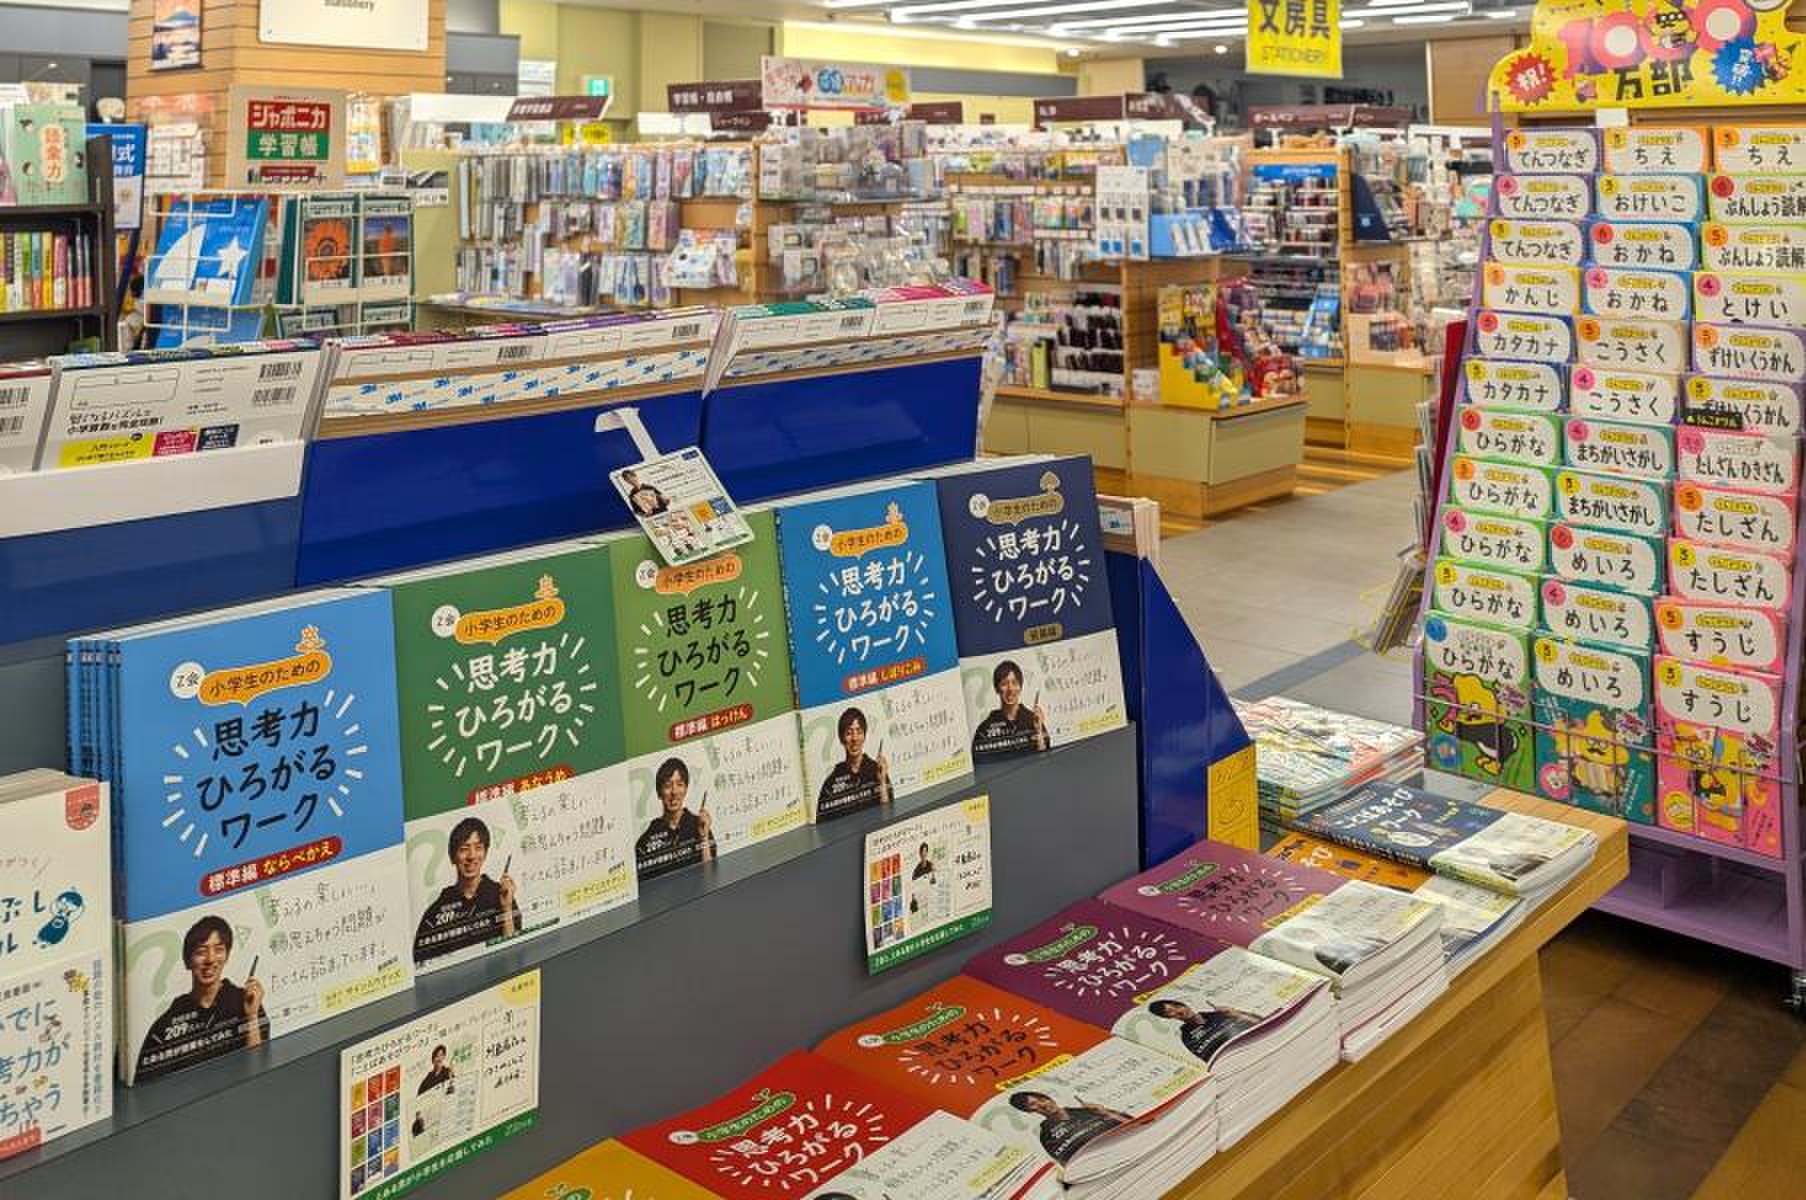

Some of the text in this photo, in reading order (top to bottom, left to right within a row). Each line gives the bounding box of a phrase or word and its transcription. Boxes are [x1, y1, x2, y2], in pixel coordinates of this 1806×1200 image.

[1615, 59, 1695, 101] 万部
[252, 104, 327, 129] ジャポニカ
[258, 133, 319, 157] 学習帳
[1518, 148, 1589, 168] てんつなぎ
[1635, 147, 1676, 165] ちえ
[1749, 146, 1793, 166] ちえ
[1510, 193, 1580, 212] てんつなぎ
[1615, 194, 1687, 213] おけいこ
[1502, 240, 1573, 260] てんつなぎ
[1613, 245, 1676, 264] おかね
[1505, 287, 1560, 308] かんじ
[1607, 292, 1669, 312] おかね
[1722, 298, 1789, 318] とけい
[1494, 335, 1559, 357] カタカナ
[1596, 341, 1667, 364] こうさく
[1708, 351, 1796, 374] ずけいくうかん
[1483, 382, 1549, 404] カタカナ
[1589, 393, 1660, 417] こうさく
[1476, 431, 1546, 456] ひらがな
[1577, 444, 1665, 472] まちがいさがし
[1468, 484, 1539, 511] ひらがな
[1567, 496, 1656, 527] まちがいさがし
[997, 525, 1061, 561] 思考力
[1696, 511, 1779, 543] たしざん
[1460, 534, 1533, 563] ひらがな
[842, 557, 906, 597] 思考力
[991, 556, 1074, 594] ひろがる
[1571, 553, 1636, 581] めいろ
[1690, 567, 1775, 601] たしざん
[666, 594, 737, 638] 思考力
[834, 590, 918, 633] ひろがる
[1009, 587, 1066, 621] ワーク
[1451, 587, 1524, 618] ひらがな
[464, 606, 556, 637] 小学生のための
[1565, 609, 1631, 639] めいろ
[657, 630, 750, 678] ひろがる
[851, 624, 909, 661] ワーク
[1685, 628, 1755, 657] すうじ
[467, 642, 557, 694] 思考力
[1442, 647, 1515, 677] ひらがな
[176, 671, 200, 689] Z会
[208, 659, 321, 698] 小学生のための
[675, 667, 741, 708] ワーク
[1557, 667, 1623, 700] めいろ
[455, 680, 573, 737] ひろがる
[1680, 686, 1754, 723] すうじ
[212, 700, 319, 761] 思考力
[476, 724, 559, 773] ワーク
[196, 744, 337, 813] ひろがる
[219, 792, 319, 849] ワーク
[207, 840, 335, 894] 標準編 ならべかえ
[1060, 929, 1125, 975] 思考力
[1077, 943, 1158, 989] ひろがる
[1113, 960, 1170, 998] ワーク
[918, 1020, 991, 1057] 思考力
[934, 1029, 1028, 1072] ひろがる
[973, 1046, 1037, 1078] ワーク
[731, 1110, 820, 1158] 思考力
[748, 1120, 858, 1176] ひろがる
[788, 1143, 866, 1184] ワーク
